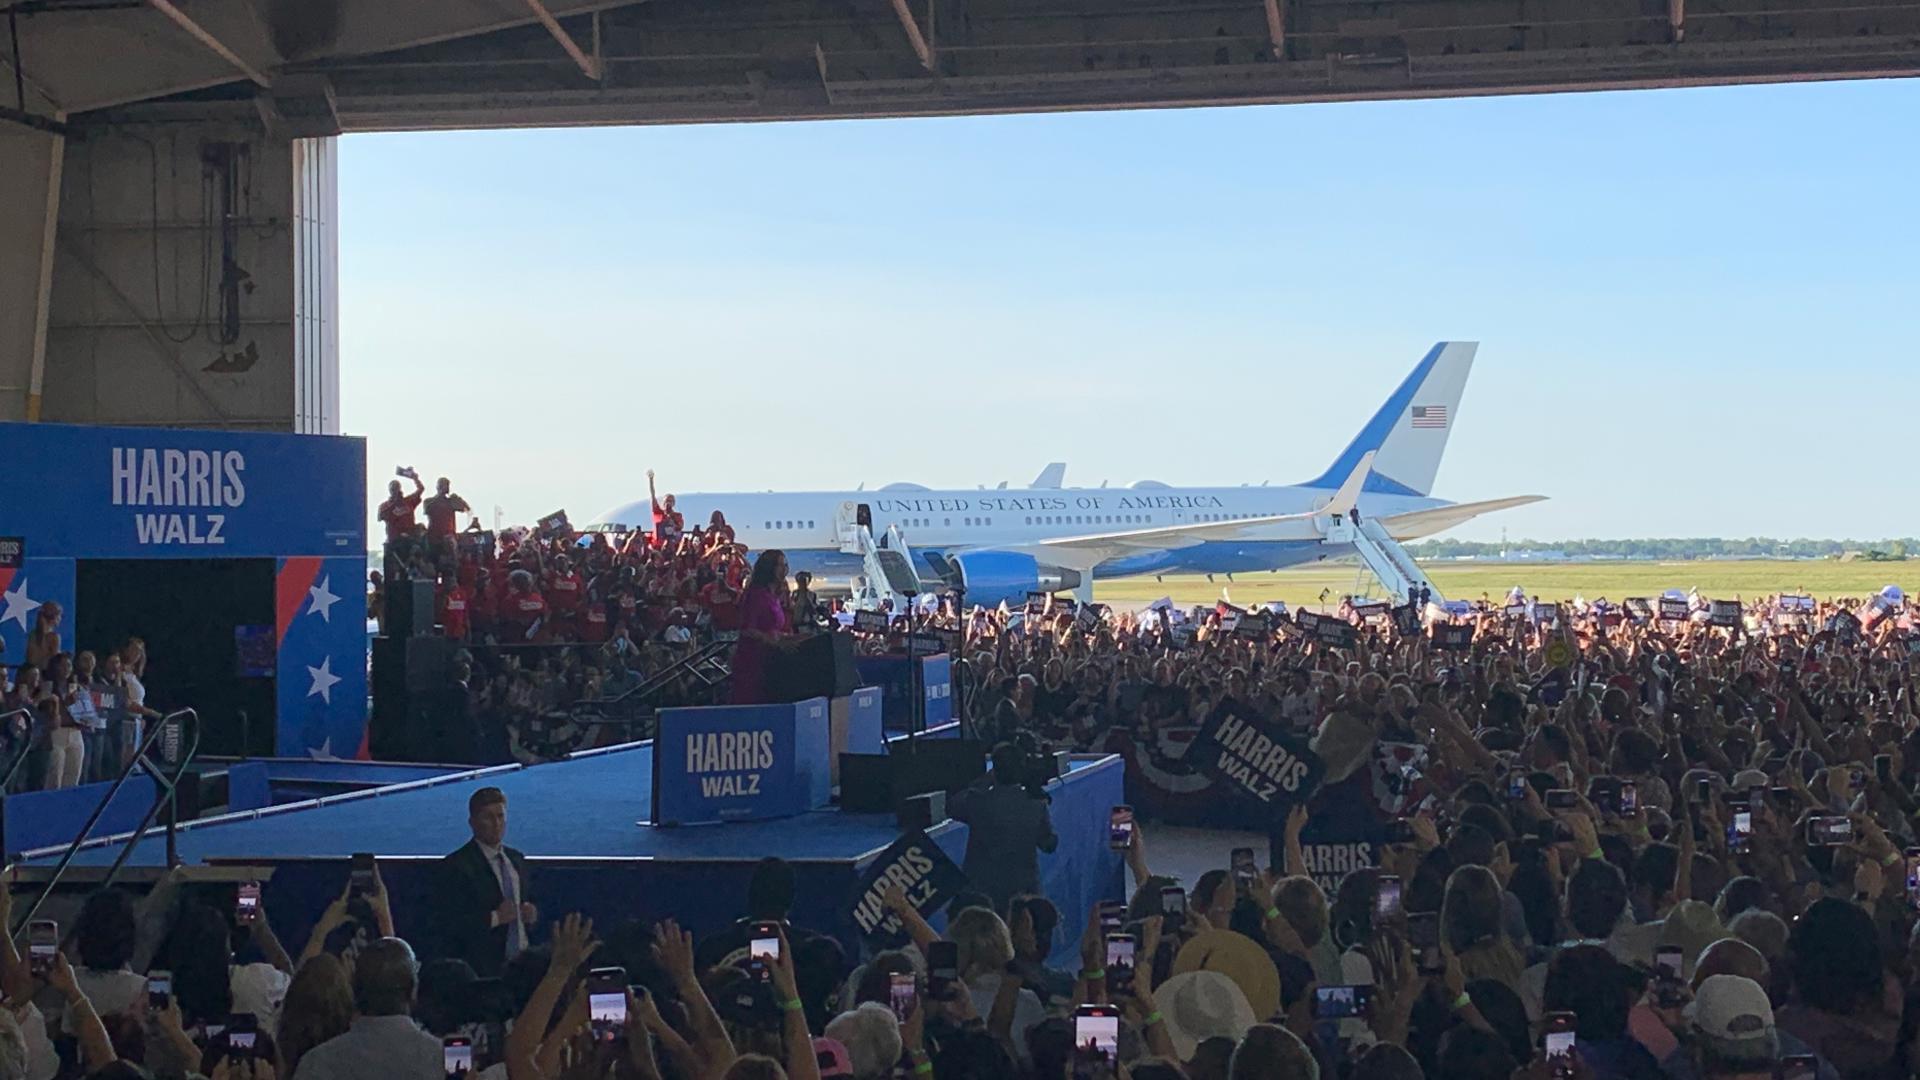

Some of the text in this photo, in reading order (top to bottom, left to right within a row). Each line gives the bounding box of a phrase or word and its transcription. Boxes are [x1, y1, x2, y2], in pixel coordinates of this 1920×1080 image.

[112, 447, 246, 508] HARRIS
[877, 495, 1224, 513] UNITED STATES OF AMERICA
[135, 513, 226, 544] WALZ
[686, 729, 774, 773] HARRIS
[1213, 713, 1309, 792] HARRIS
[701, 774, 761, 798] WALZ
[1217, 750, 1277, 802] WALZ
[1283, 841, 1372, 873] ARRIS
[881, 879, 939, 935] WLZ
